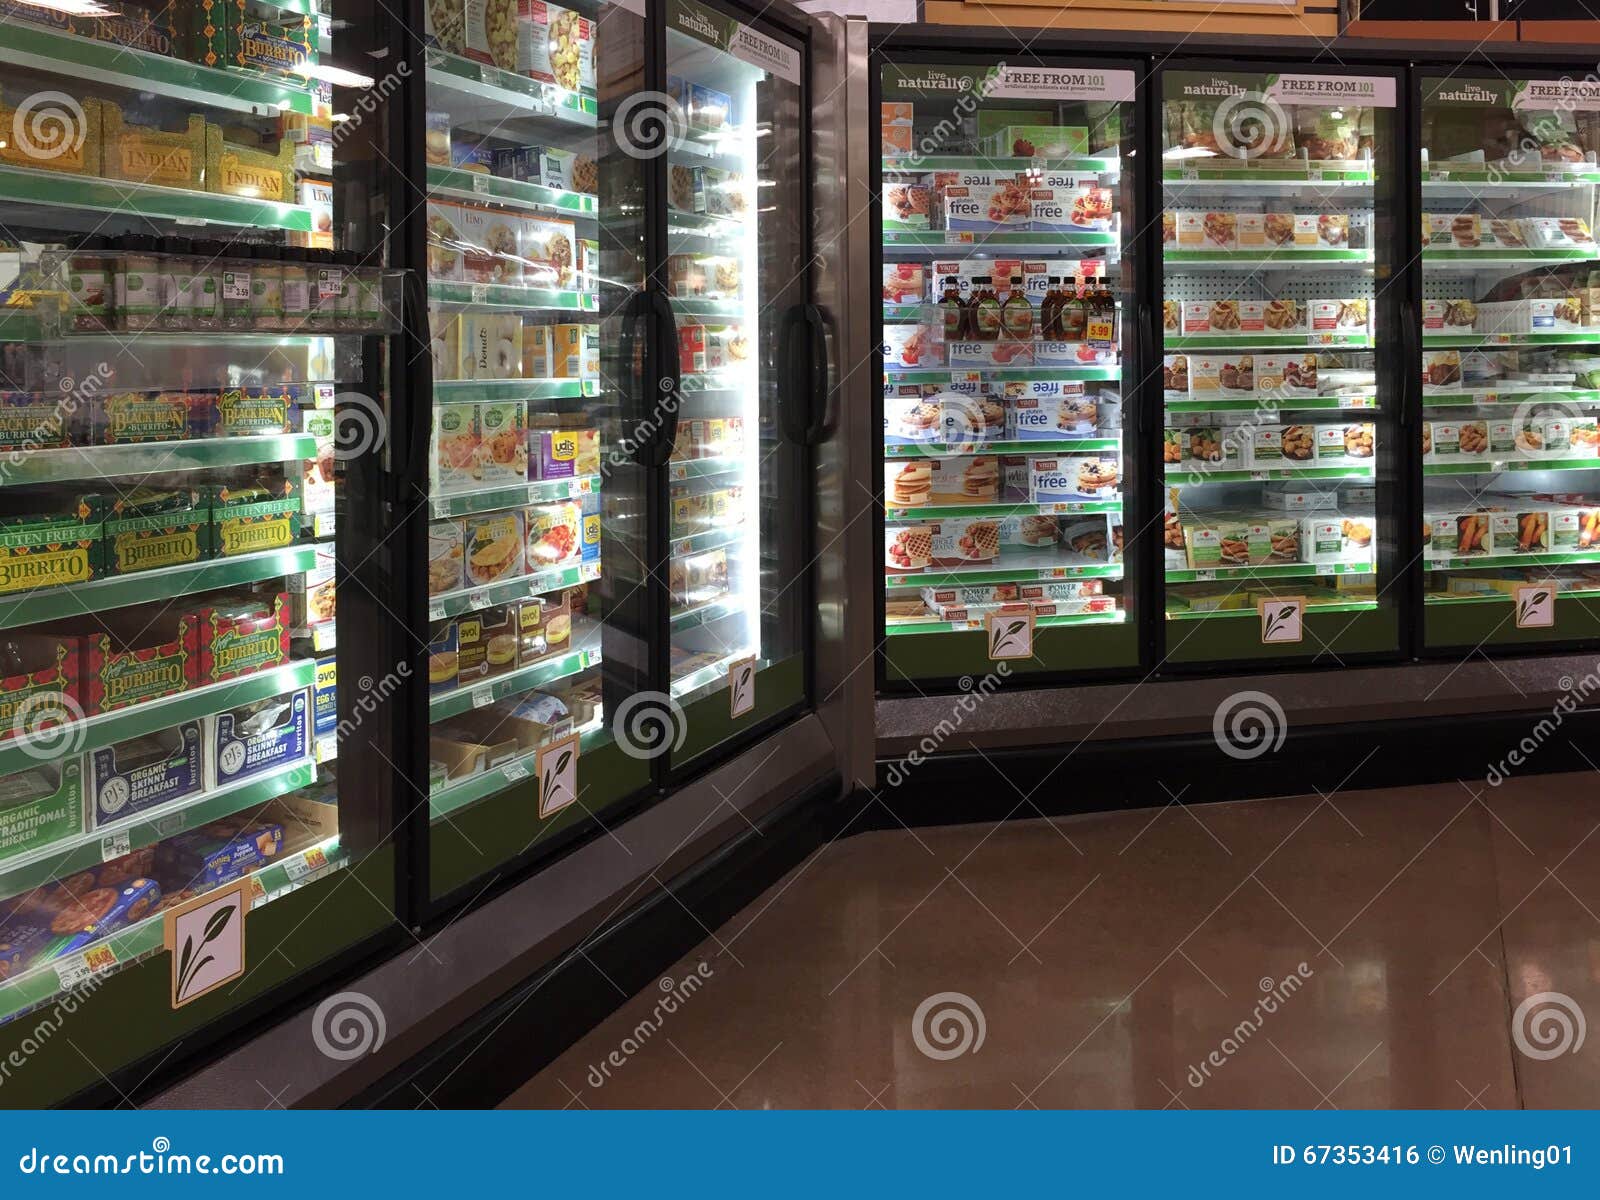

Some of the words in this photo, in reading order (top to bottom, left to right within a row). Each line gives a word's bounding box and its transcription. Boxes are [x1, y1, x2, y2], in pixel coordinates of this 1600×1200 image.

[679, 13, 719, 43] naturally
[244, 38, 305, 66] BURRITO
[739, 31, 758, 50] FREE
[759, 40, 780, 60] FROM
[927, 70, 946, 80] live
[1004, 72, 1040, 84] FREE
[1043, 73, 1085, 86] FROM
[1088, 75, 1104, 86] 101
[1211, 78, 1229, 87] live
[897, 76, 965, 93] naturally
[1184, 84, 1247, 99] naturally
[1282, 80, 1315, 90] FREE
[1317, 80, 1356, 92] FROM
[1360, 82, 1374, 92] 101
[1465, 84, 1480, 93] live
[1530, 85, 1561, 96] FREE
[1563, 86, 1600, 97] FROM
[1439, 90, 1498, 105] naturally
[128, 150, 189, 173] INDIAN
[227, 170, 280, 193] INDIAN
[1048, 176, 1074, 188] free
[950, 202, 979, 214] free
[1034, 205, 1062, 217] free
[938, 278, 969, 292] fe
[1028, 277, 1051, 291] fre
[1090, 325, 1109, 338] 5.99
[479, 328, 488, 370] Donuts
[113, 410, 153, 432] BLACK
[155, 409, 185, 429] BEAN
[224, 408, 260, 426] BLACK
[260, 407, 284, 425] BEAN
[238, 418, 270, 426] BURRITO
[1019, 413, 1047, 425] free
[131, 422, 168, 431] BURRITO
[1039, 476, 1067, 488] free
[223, 506, 261, 519] GLUTEN
[263, 502, 284, 514] FREE
[118, 517, 162, 532] GLUTEN
[164, 513, 187, 525] FREE
[46, 529, 76, 542] FREE
[229, 524, 287, 551] BURRITO
[125, 537, 193, 567] BURRITO
[0, 555, 83, 586] BURRITO
[961, 586, 990, 597] POWER
[1049, 582, 1077, 592] POWER
[220, 637, 278, 667] BURRITO
[111, 664, 181, 698] BURRITO
[316, 693, 330, 705] EGG
[247, 730, 278, 747] ORGANIC
[295, 715, 303, 753] burritos
[224, 745, 243, 767] PJ's
[246, 743, 288, 765] BREAKFAST
[247, 740, 276, 756] SKINNY
[131, 762, 168, 782] ORGANIC
[188, 745, 197, 787] burritos
[131, 772, 167, 792] SKINNY
[131, 776, 180, 801] BREAKFAST
[104, 781, 125, 804] PJ's
[67, 784, 77, 829] burritos
